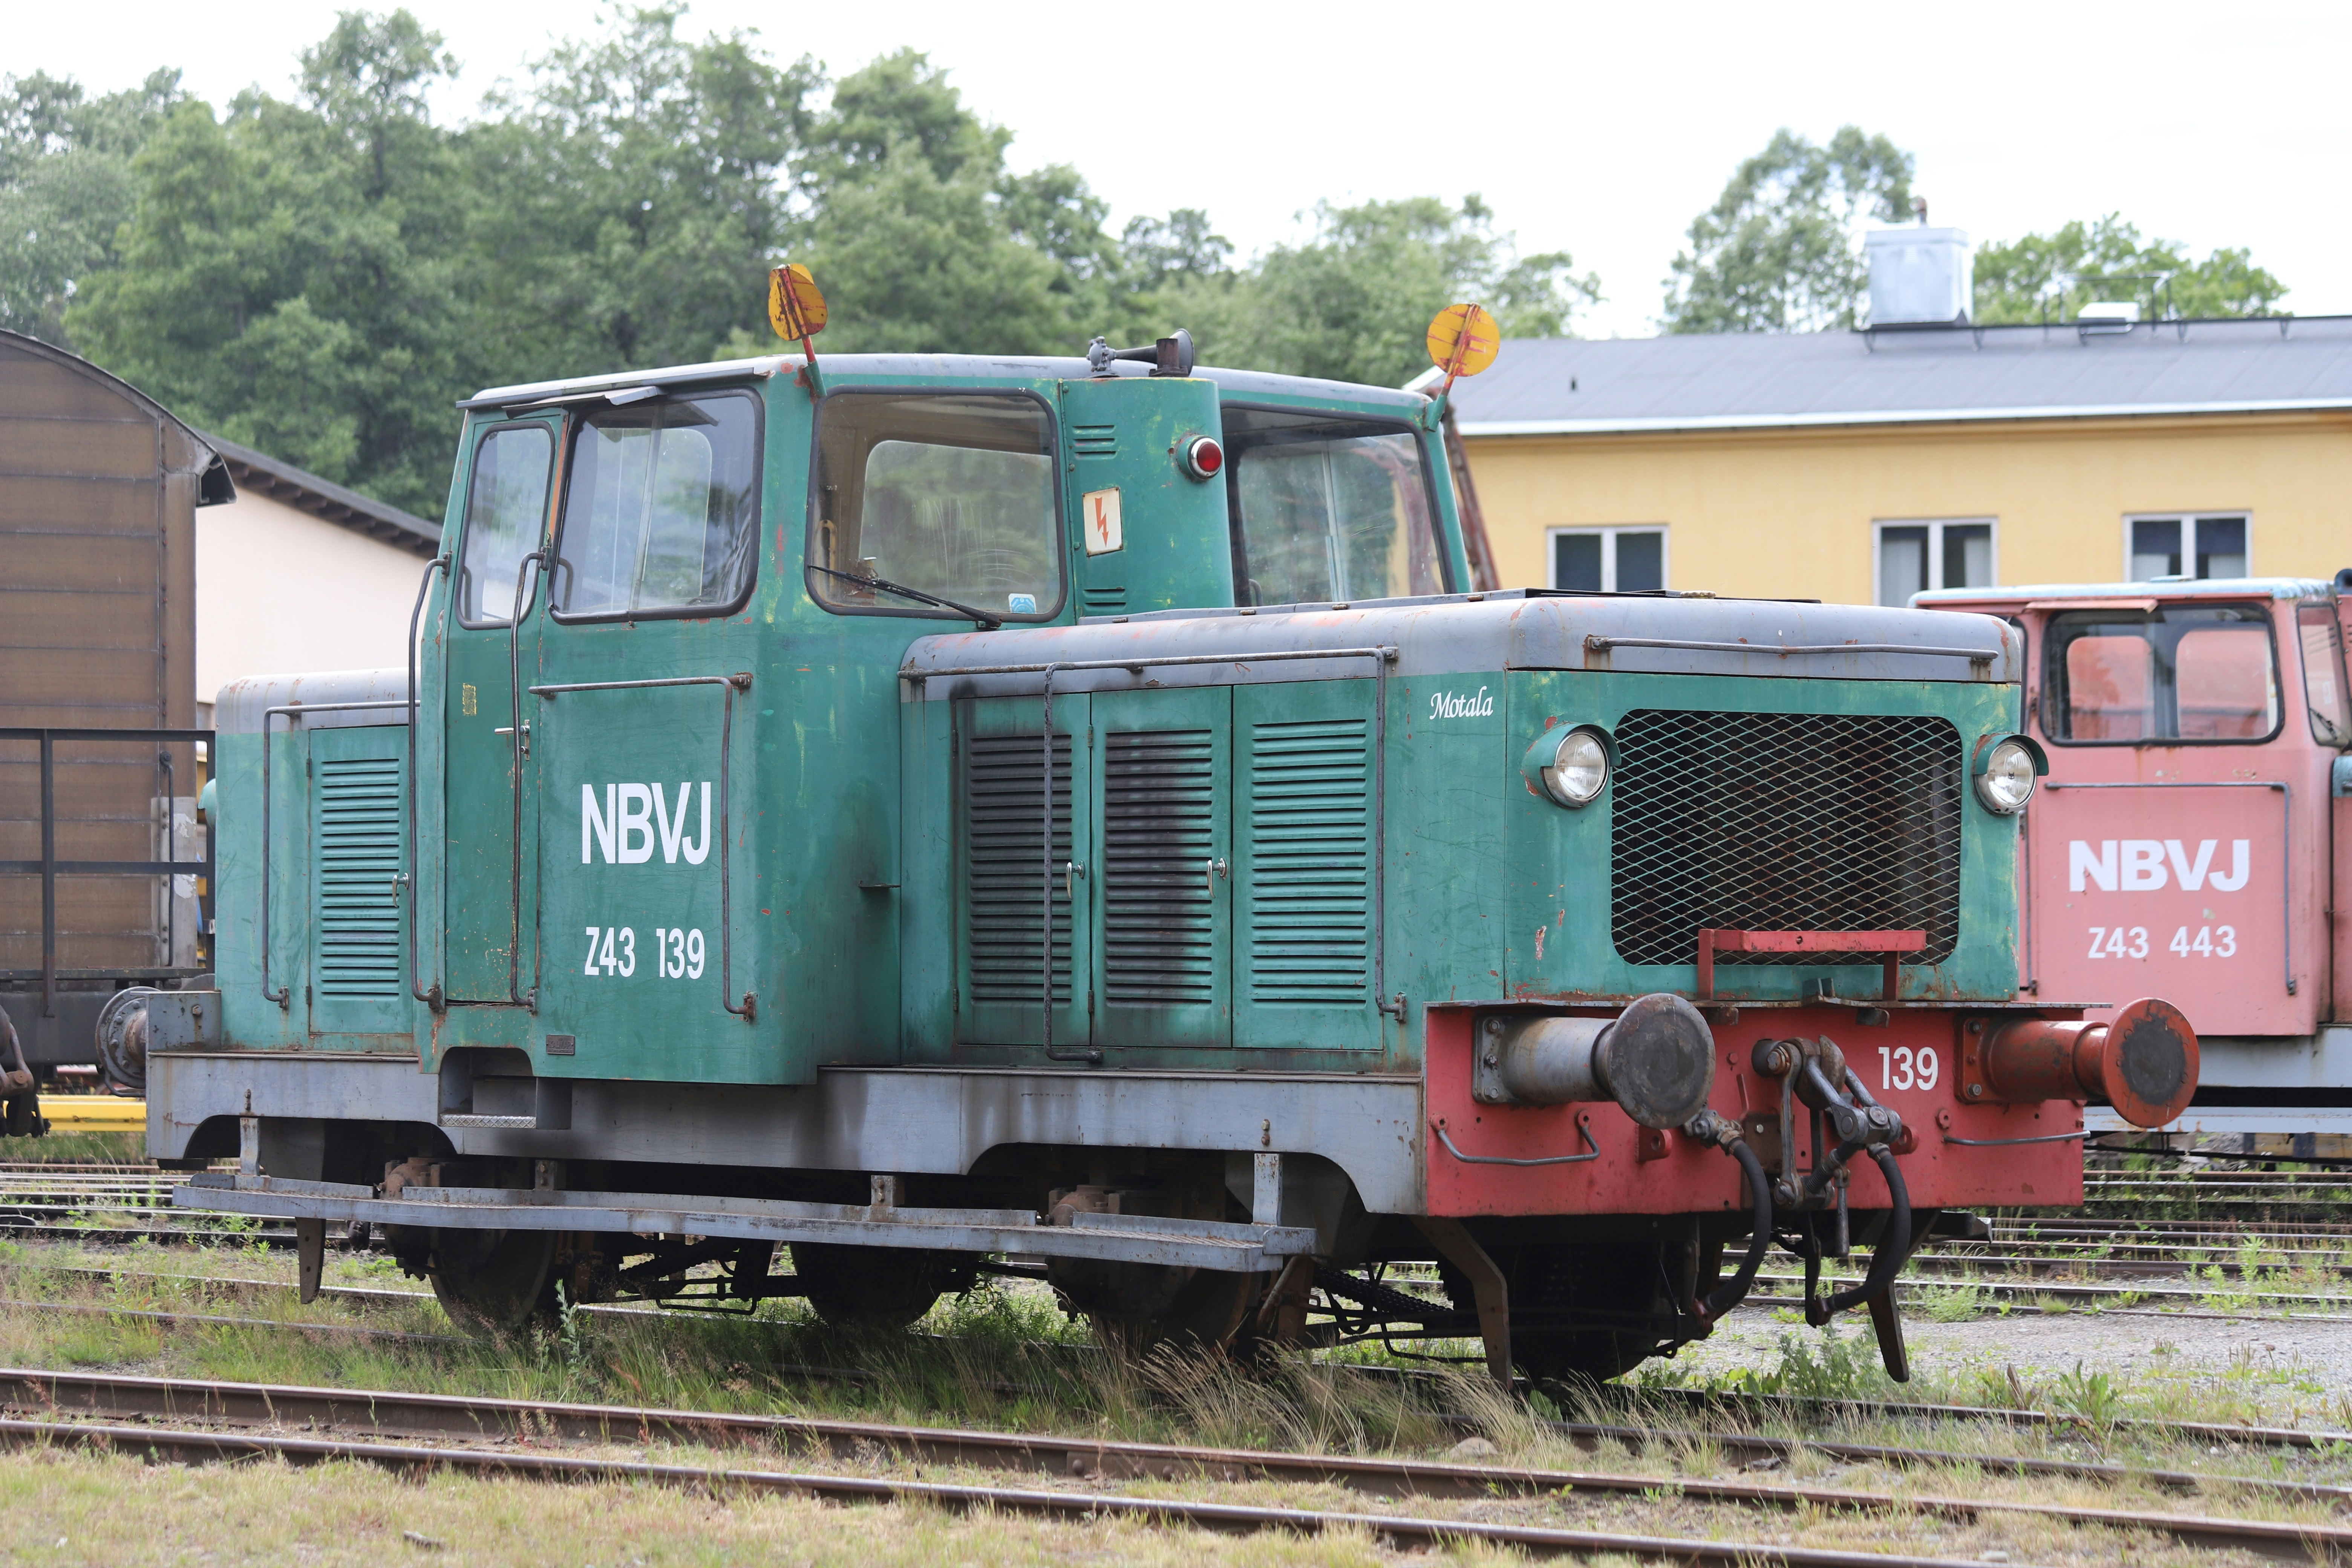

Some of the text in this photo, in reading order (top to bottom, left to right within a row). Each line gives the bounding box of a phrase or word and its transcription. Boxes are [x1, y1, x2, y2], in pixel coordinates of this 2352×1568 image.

[1429, 686, 1493, 720] Motala
[582, 782, 711, 865] NBVJ
[2069, 839, 2249, 892] NBVJ
[585, 927, 705, 979] Z43 139
[2088, 925, 2236, 959] Z43 443
[1878, 1046, 1939, 1091] 139
